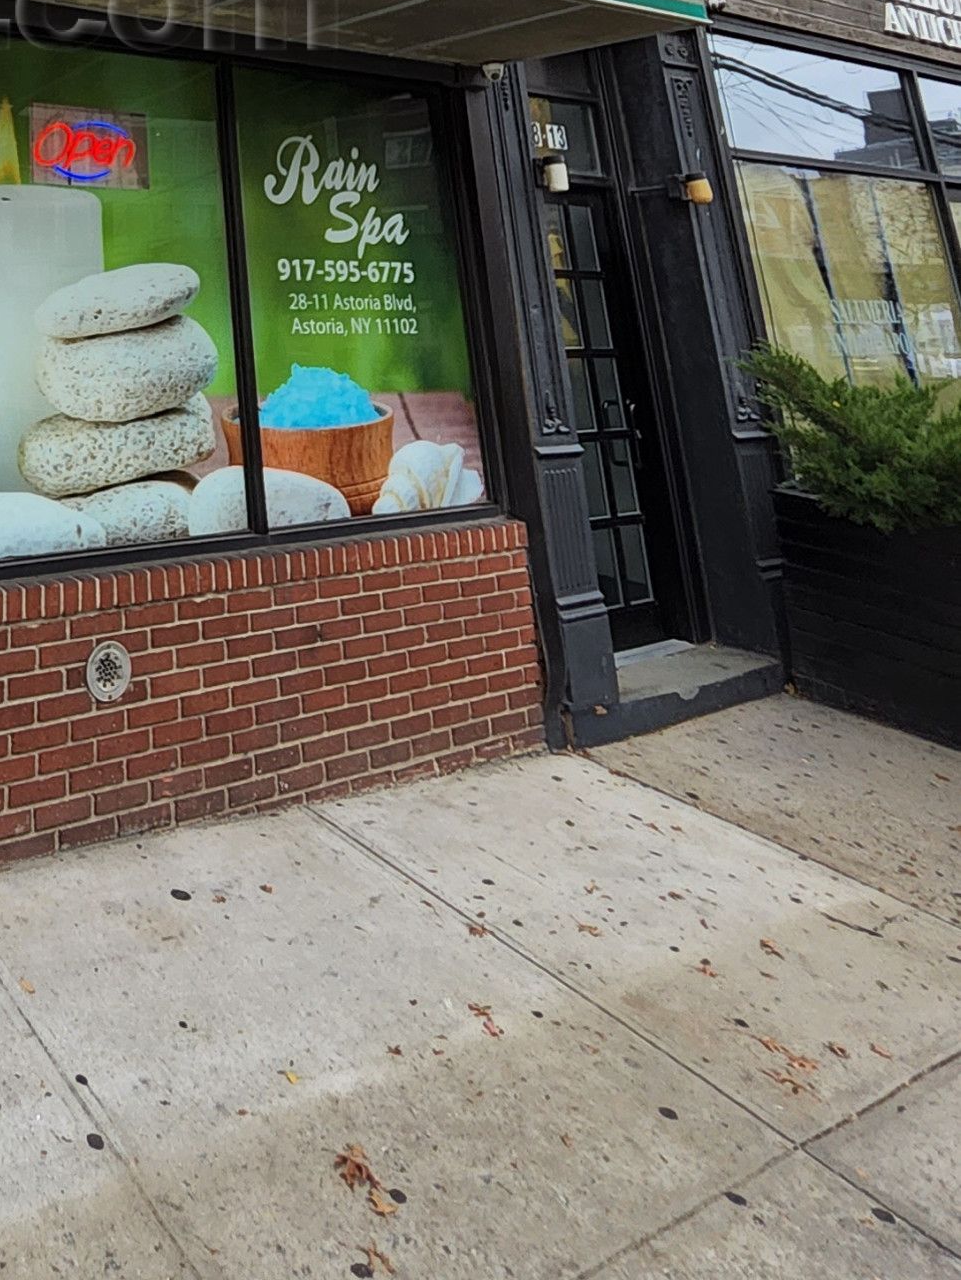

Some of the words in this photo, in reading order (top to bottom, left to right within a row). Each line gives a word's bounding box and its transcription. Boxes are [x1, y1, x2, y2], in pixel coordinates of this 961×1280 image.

[33, 120, 136, 169] Open
[264, 135, 380, 205] Rain
[324, 191, 410, 259] Spa
[278, 258, 415, 284] 917-595-6775
[288, 293, 328, 310] 28-11
[333, 293, 381, 311] Astoria
[383, 293, 417, 314] Blvd,
[291, 317, 348, 337] Astoria,
[350, 317, 372, 334] NY
[375, 318, 418, 334] 11102
